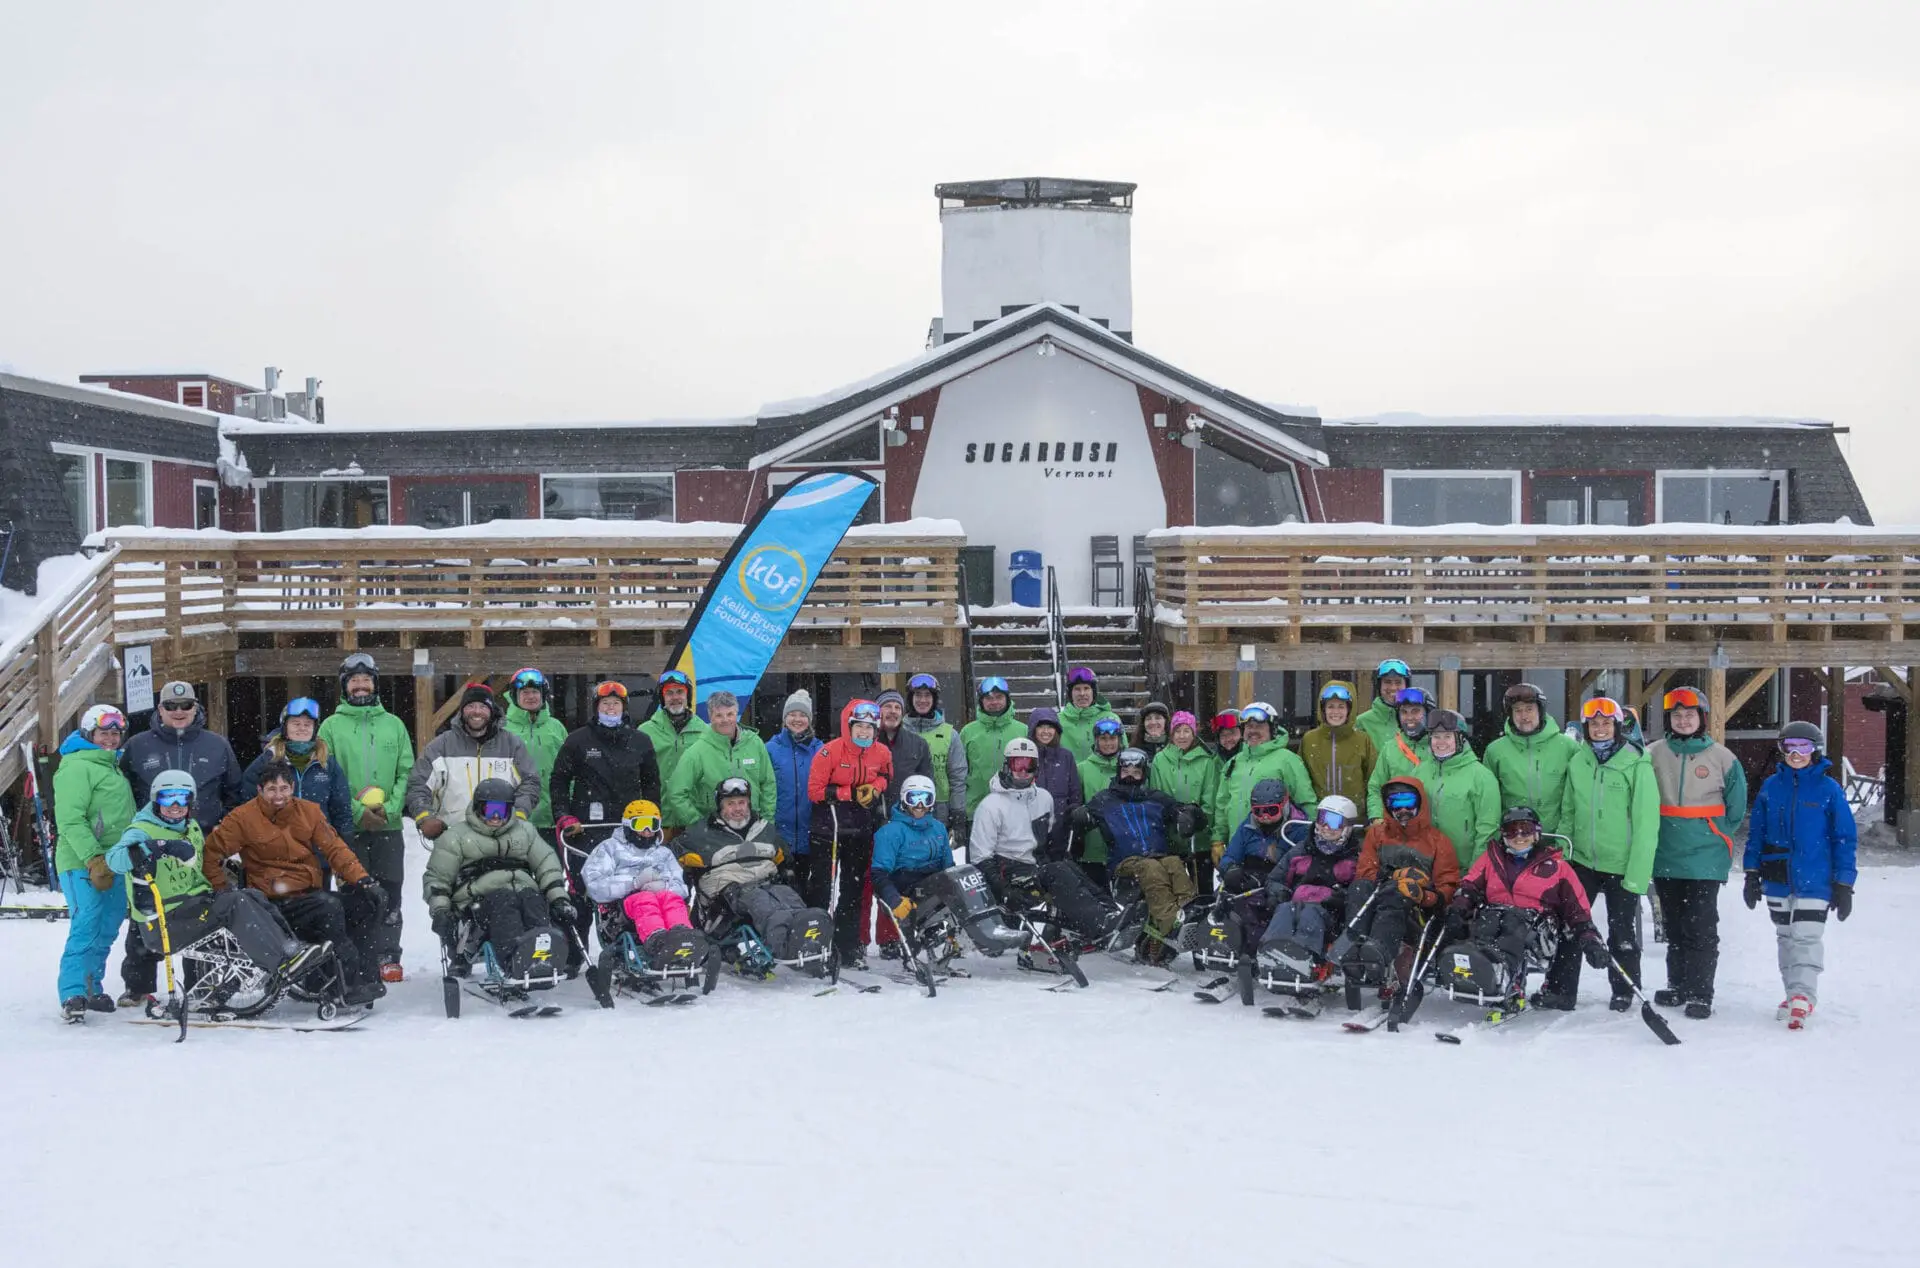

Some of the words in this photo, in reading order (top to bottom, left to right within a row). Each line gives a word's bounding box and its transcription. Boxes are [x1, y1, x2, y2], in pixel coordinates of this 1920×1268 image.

[965, 442, 1118, 463] SUGARBUSH
[1043, 467, 1113, 478] Vermont
[746, 556, 800, 595] kbf
[713, 605, 777, 646] Foundation
[720, 595, 752, 619] Kelly
[750, 611, 783, 635] Brush
